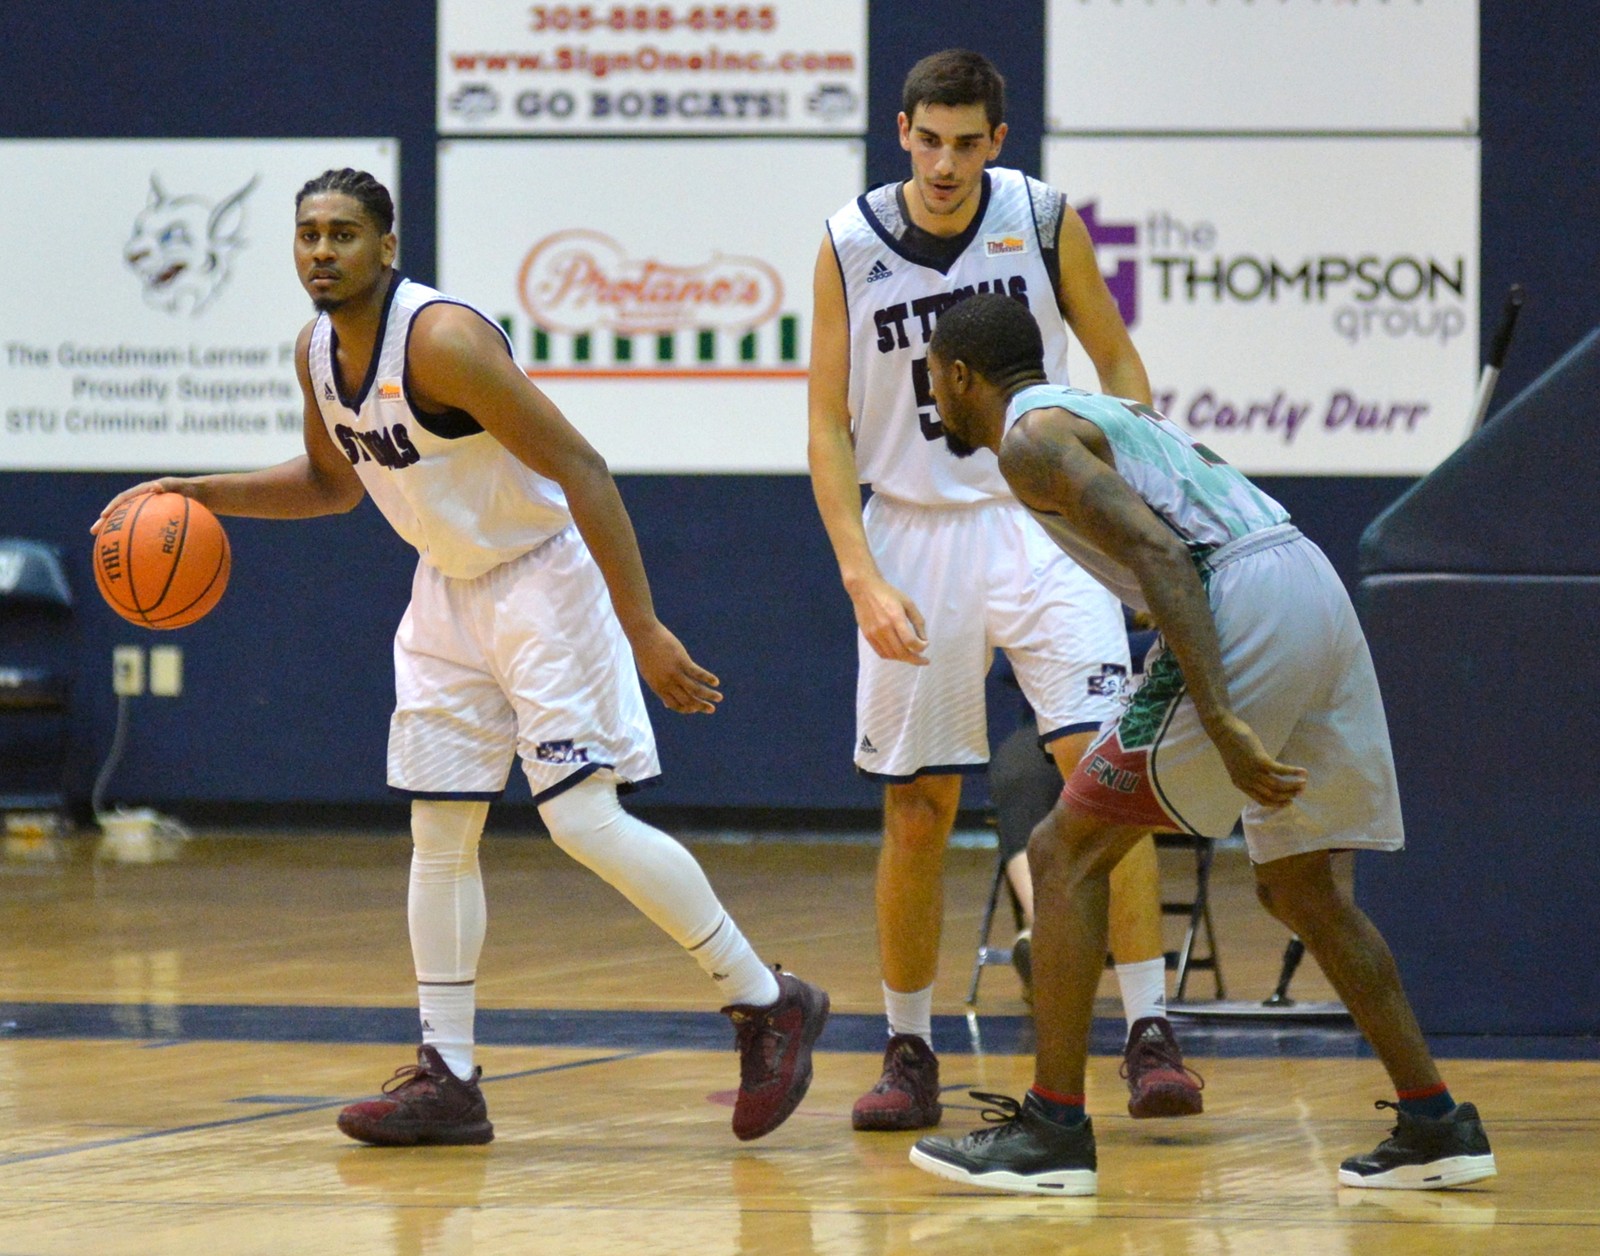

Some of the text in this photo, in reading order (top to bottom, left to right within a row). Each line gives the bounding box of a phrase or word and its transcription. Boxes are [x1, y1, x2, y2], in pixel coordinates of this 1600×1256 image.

[451, 46, 854, 76] www.SignOneInc.com
[516, 91, 576, 119] GO
[590, 91, 788, 119] BOBCATS!
[1146, 212, 1216, 249] the
[866, 270, 893, 284] adidas
[1150, 255, 1464, 301] THOMPSON
[874, 303, 910, 354] ST
[1333, 305, 1466, 343] group
[5, 342, 50, 367] The
[73, 376, 292, 403] Proudly Supports
[6, 409, 57, 434] STU
[65, 408, 168, 434] Criminal
[177, 411, 270, 435] Justice
[1187, 391, 1310, 445] Carly
[1324, 389, 1428, 430] Durr
[162, 516, 180, 555] ROCK
[102, 541, 121, 584] THE
[1085, 754, 1140, 793] FNU
